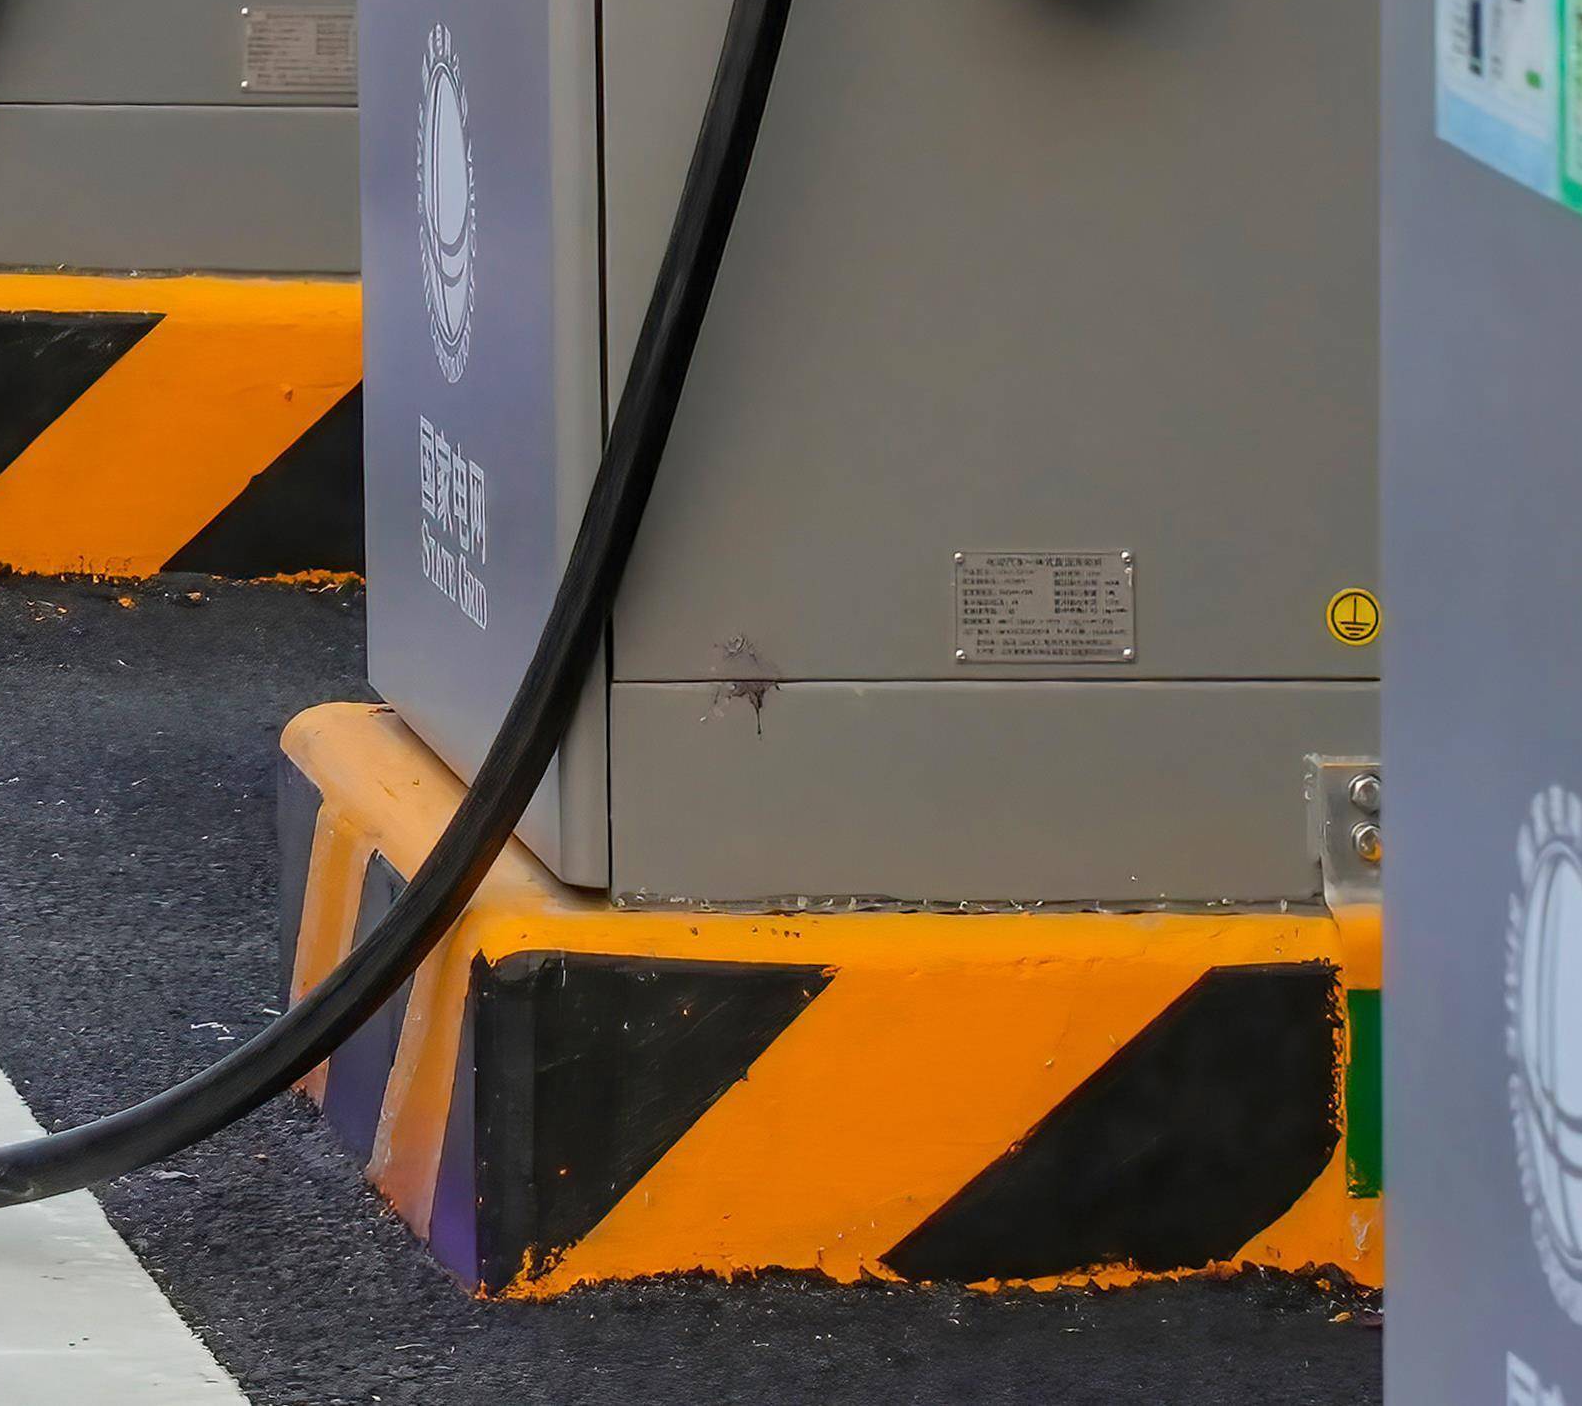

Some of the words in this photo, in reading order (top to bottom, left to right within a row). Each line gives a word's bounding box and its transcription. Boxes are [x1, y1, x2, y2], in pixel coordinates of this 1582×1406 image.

[420, 415, 486, 565] 国家电网
[422, 518, 457, 603] STATE
